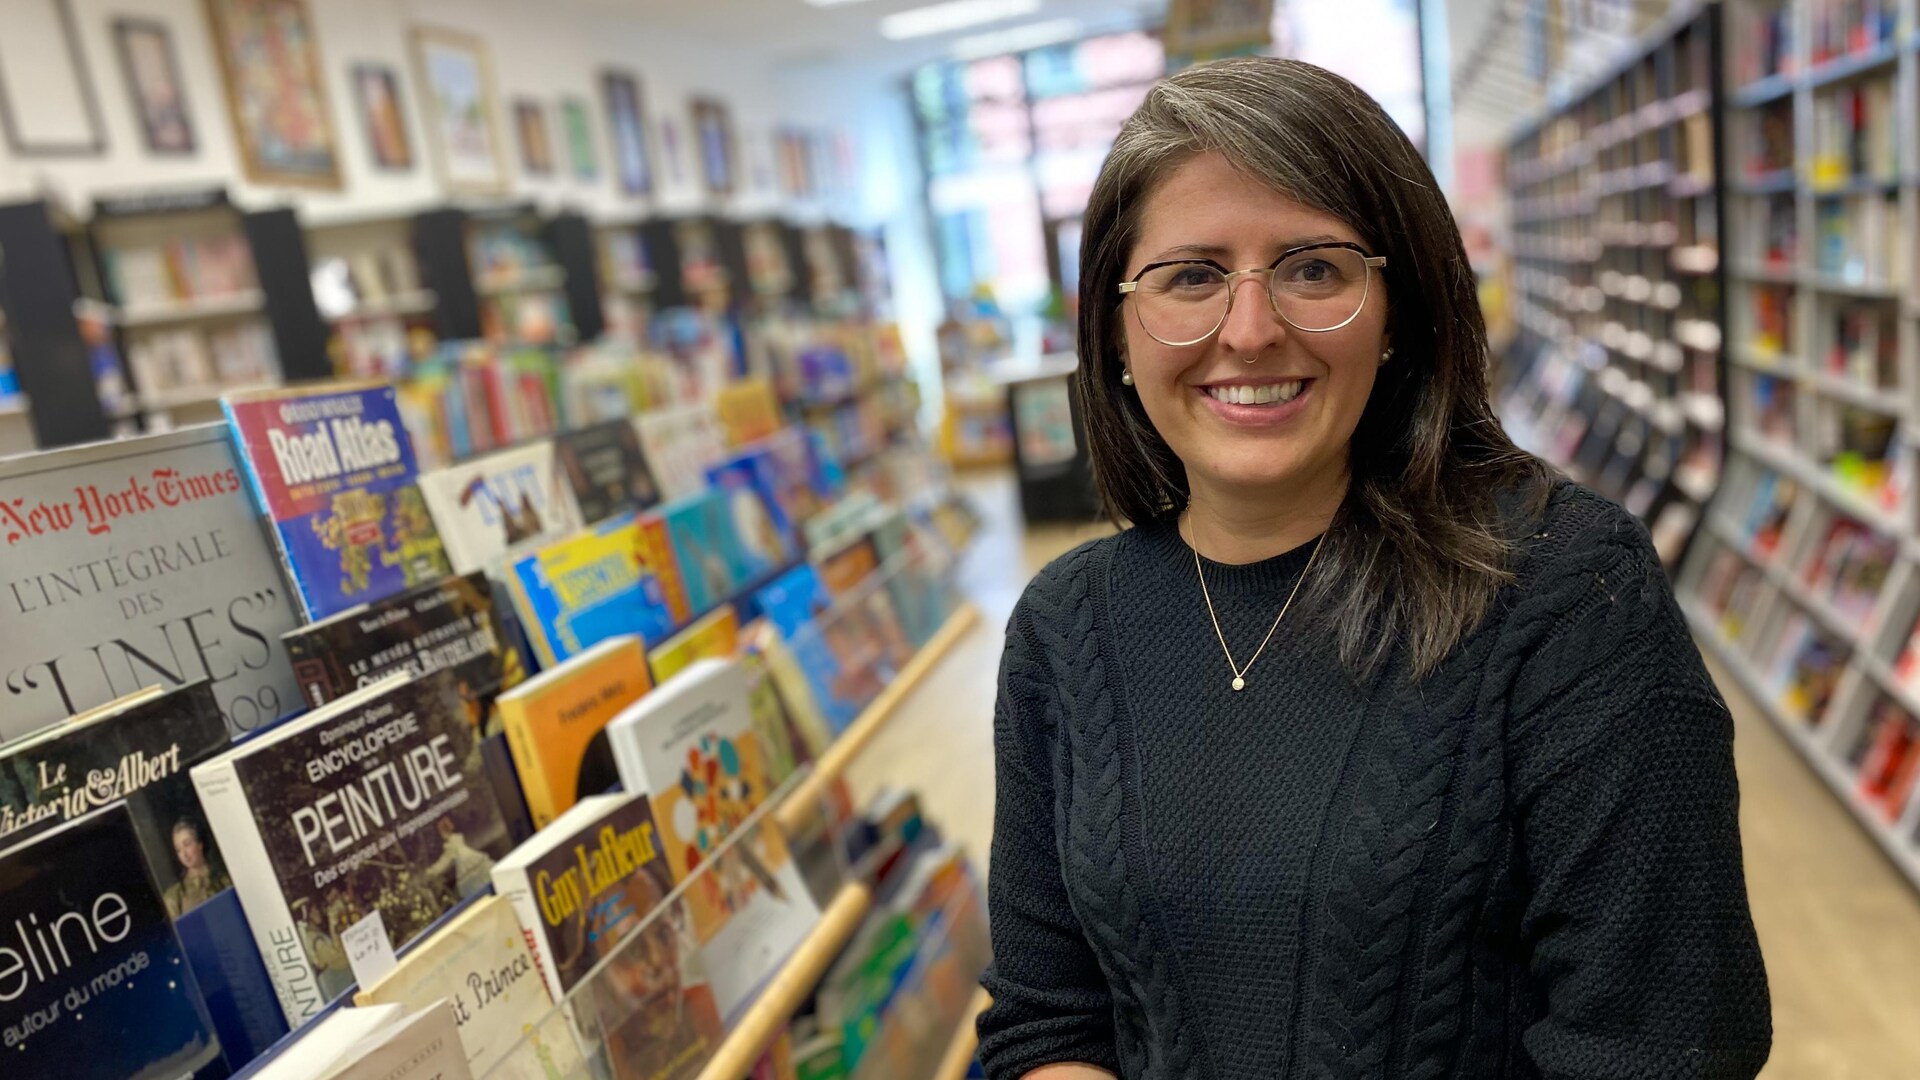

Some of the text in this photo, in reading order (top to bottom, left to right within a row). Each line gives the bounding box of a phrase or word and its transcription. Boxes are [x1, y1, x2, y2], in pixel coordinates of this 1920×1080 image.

[267, 420, 341, 485] Road
[331, 416, 401, 473] Atlas
[0, 497, 74, 545] New
[75, 475, 156, 536] York
[152, 467, 241, 508] Times
[10, 528, 231, 614] L'INTÉGRALE
[118, 589, 164, 620] DES
[223, 685, 281, 740] 09
[38, 760, 66, 790] Le
[292, 733, 463, 867] PEINTURE
[314, 866, 338, 888] Des
[536, 866, 585, 927] Guy
[575, 821, 655, 898] Lafleur
[3, 951, 150, 1047] autour du monde
[269, 926, 318, 1018] NTURE
[467, 953, 530, 1009] Prince
